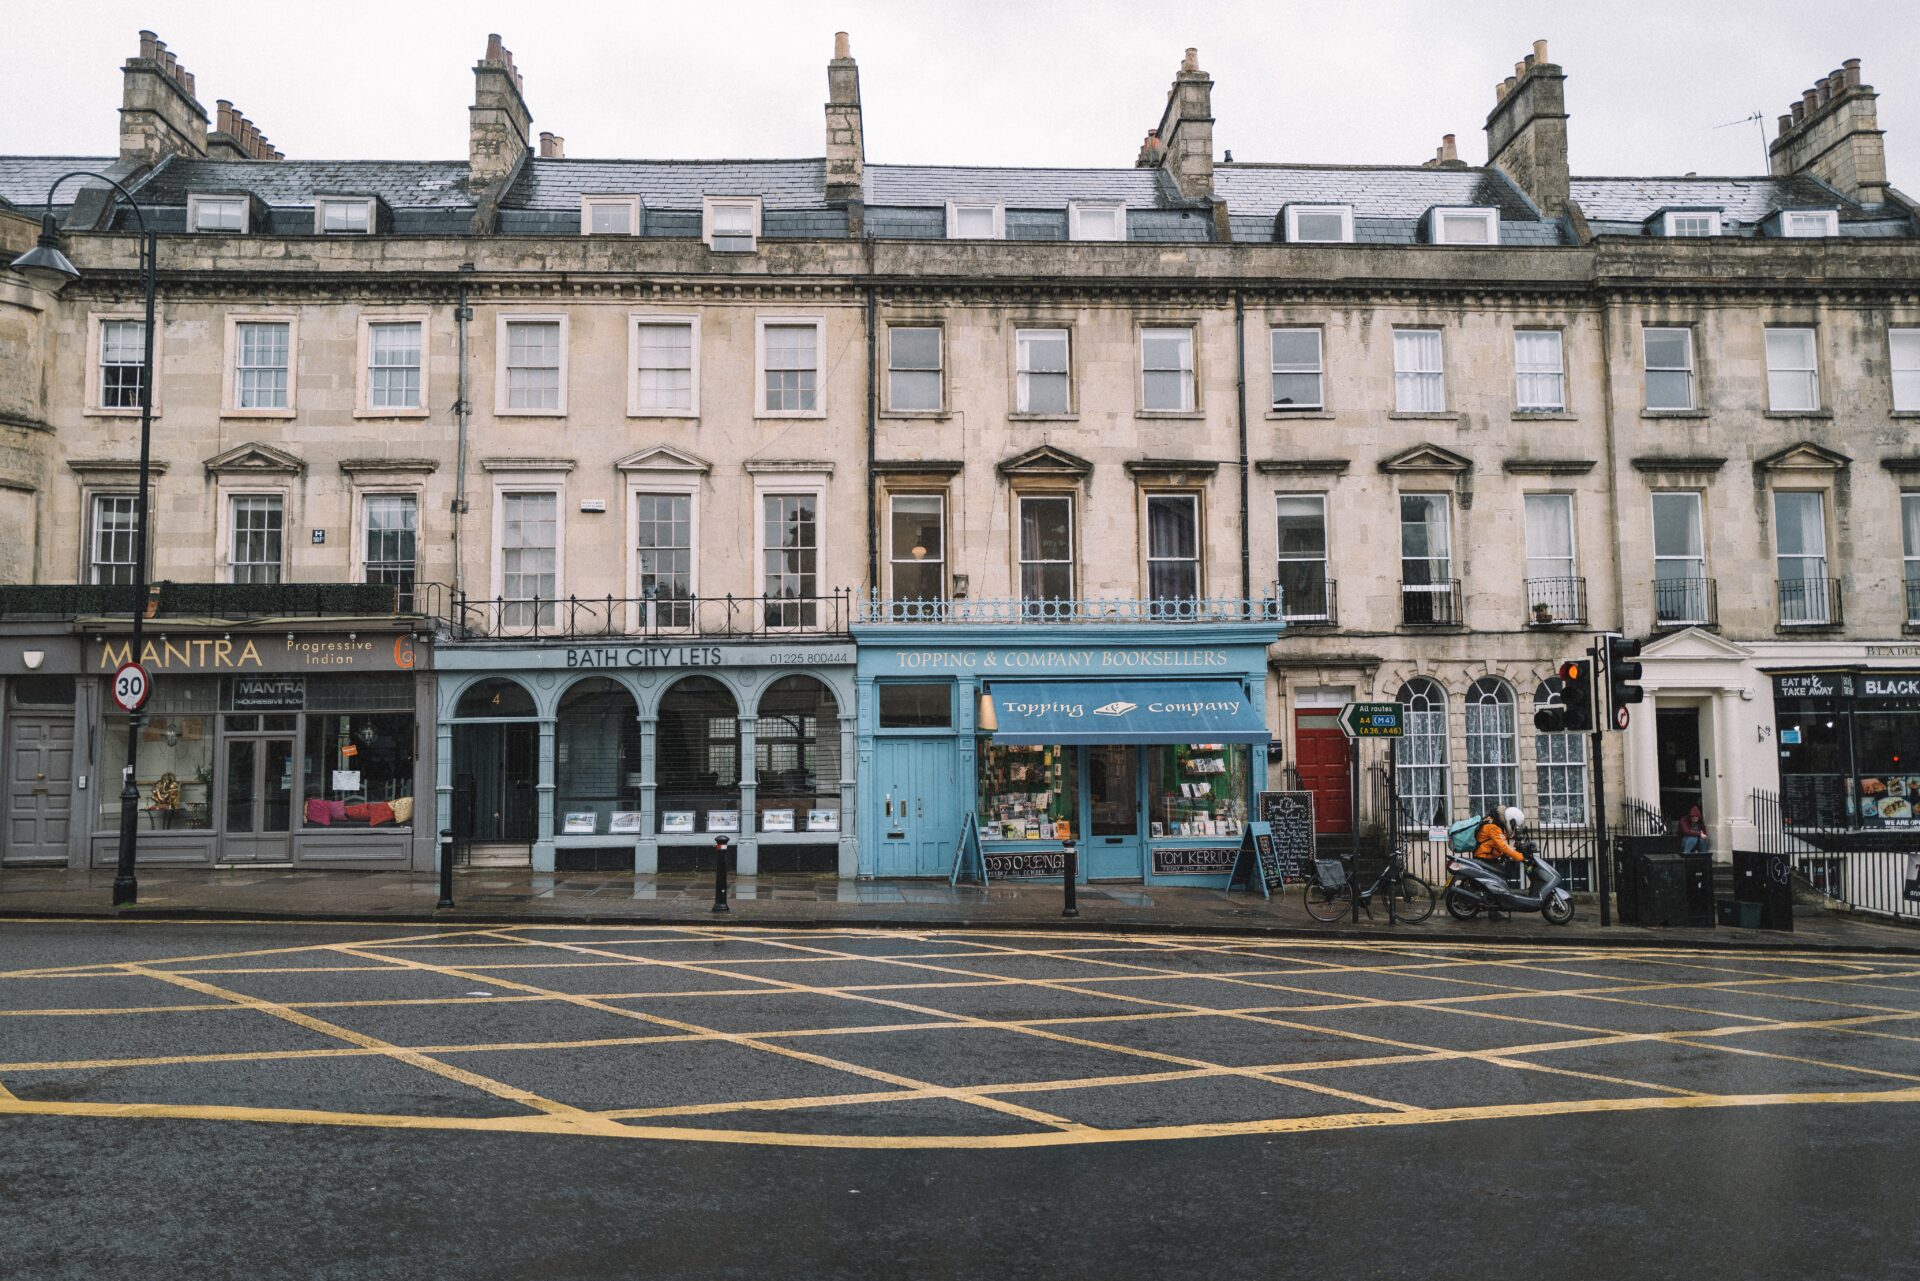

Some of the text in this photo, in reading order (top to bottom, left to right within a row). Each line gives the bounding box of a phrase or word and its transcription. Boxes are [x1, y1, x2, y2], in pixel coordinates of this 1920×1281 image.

[287, 640, 373, 653] Progressive
[100, 639, 262, 668] MANTRA
[306, 653, 353, 665] Indian
[567, 647, 721, 667] BATH CITY LETS
[770, 652, 847, 664] 01225 800444
[896, 650, 1228, 668] TOPPING & COMPANY BOOKSELLERS
[118, 676, 142, 696] 30
[239, 682, 304, 694] MANTRA
[1781, 677, 1799, 687] EAT
[1801, 677, 1811, 686] IN
[1865, 680, 1920, 694] BLACK
[1782, 686, 1833, 696] TAKE AWAY
[491, 693, 500, 705] 4
[1002, 701, 1084, 718] Topping
[1148, 700, 1240, 717] Company
[1373, 716, 1394, 725] (M4)
[1156, 851, 1183, 865] TOM
